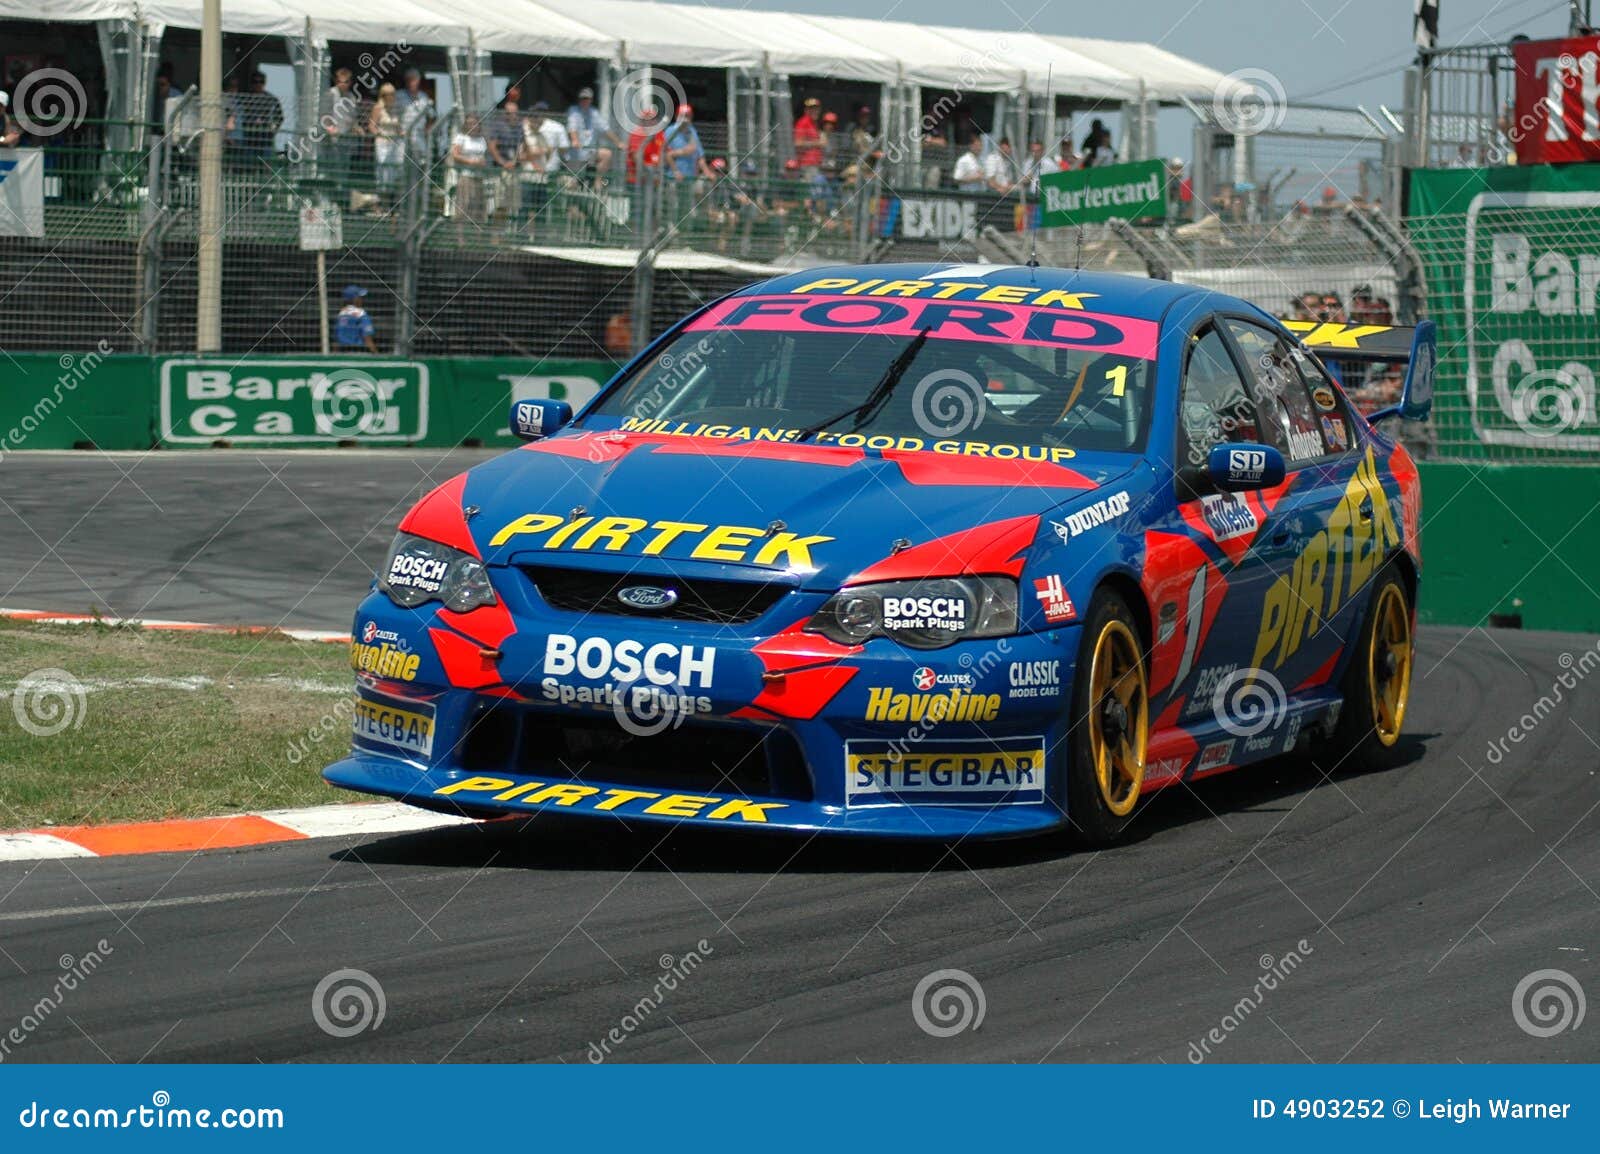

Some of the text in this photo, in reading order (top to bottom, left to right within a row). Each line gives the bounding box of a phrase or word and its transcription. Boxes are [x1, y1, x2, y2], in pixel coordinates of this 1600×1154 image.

[1045, 173, 1160, 212] Bartercard
[902, 199, 978, 239] EXIDE
[790, 278, 1102, 311] PIRTEK
[715, 298, 1125, 347] FORD
[186, 371, 407, 400] Barter
[1104, 365, 1127, 397] 1
[190, 405, 400, 435] Card
[518, 404, 542, 425] SP
[619, 417, 800, 442] MILLIGANS
[933, 440, 1077, 464] GROUP
[1230, 450, 1265, 471] SP
[1065, 490, 1131, 537] DUNLOP
[489, 513, 836, 570] PIRTEK
[388, 573, 440, 591] Spark Plugs
[391, 554, 449, 580] BOSCH
[1238, 444, 1400, 698] PIRTEK
[629, 587, 666, 605] Ford
[883, 598, 965, 619] BOSCH
[884, 617, 965, 631] Spark Plugs
[543, 633, 716, 688] BOSCH
[1009, 660, 1060, 687] CLASSIC
[936, 674, 972, 684] CALTEX
[1009, 687, 1060, 698] MODEL CARS
[541, 677, 713, 715] Spark Plugs
[865, 687, 1002, 722] Havoline
[354, 701, 430, 749] STEGBAR
[857, 756, 1034, 787] STEGBAR
[434, 776, 789, 823] PIRTEK
